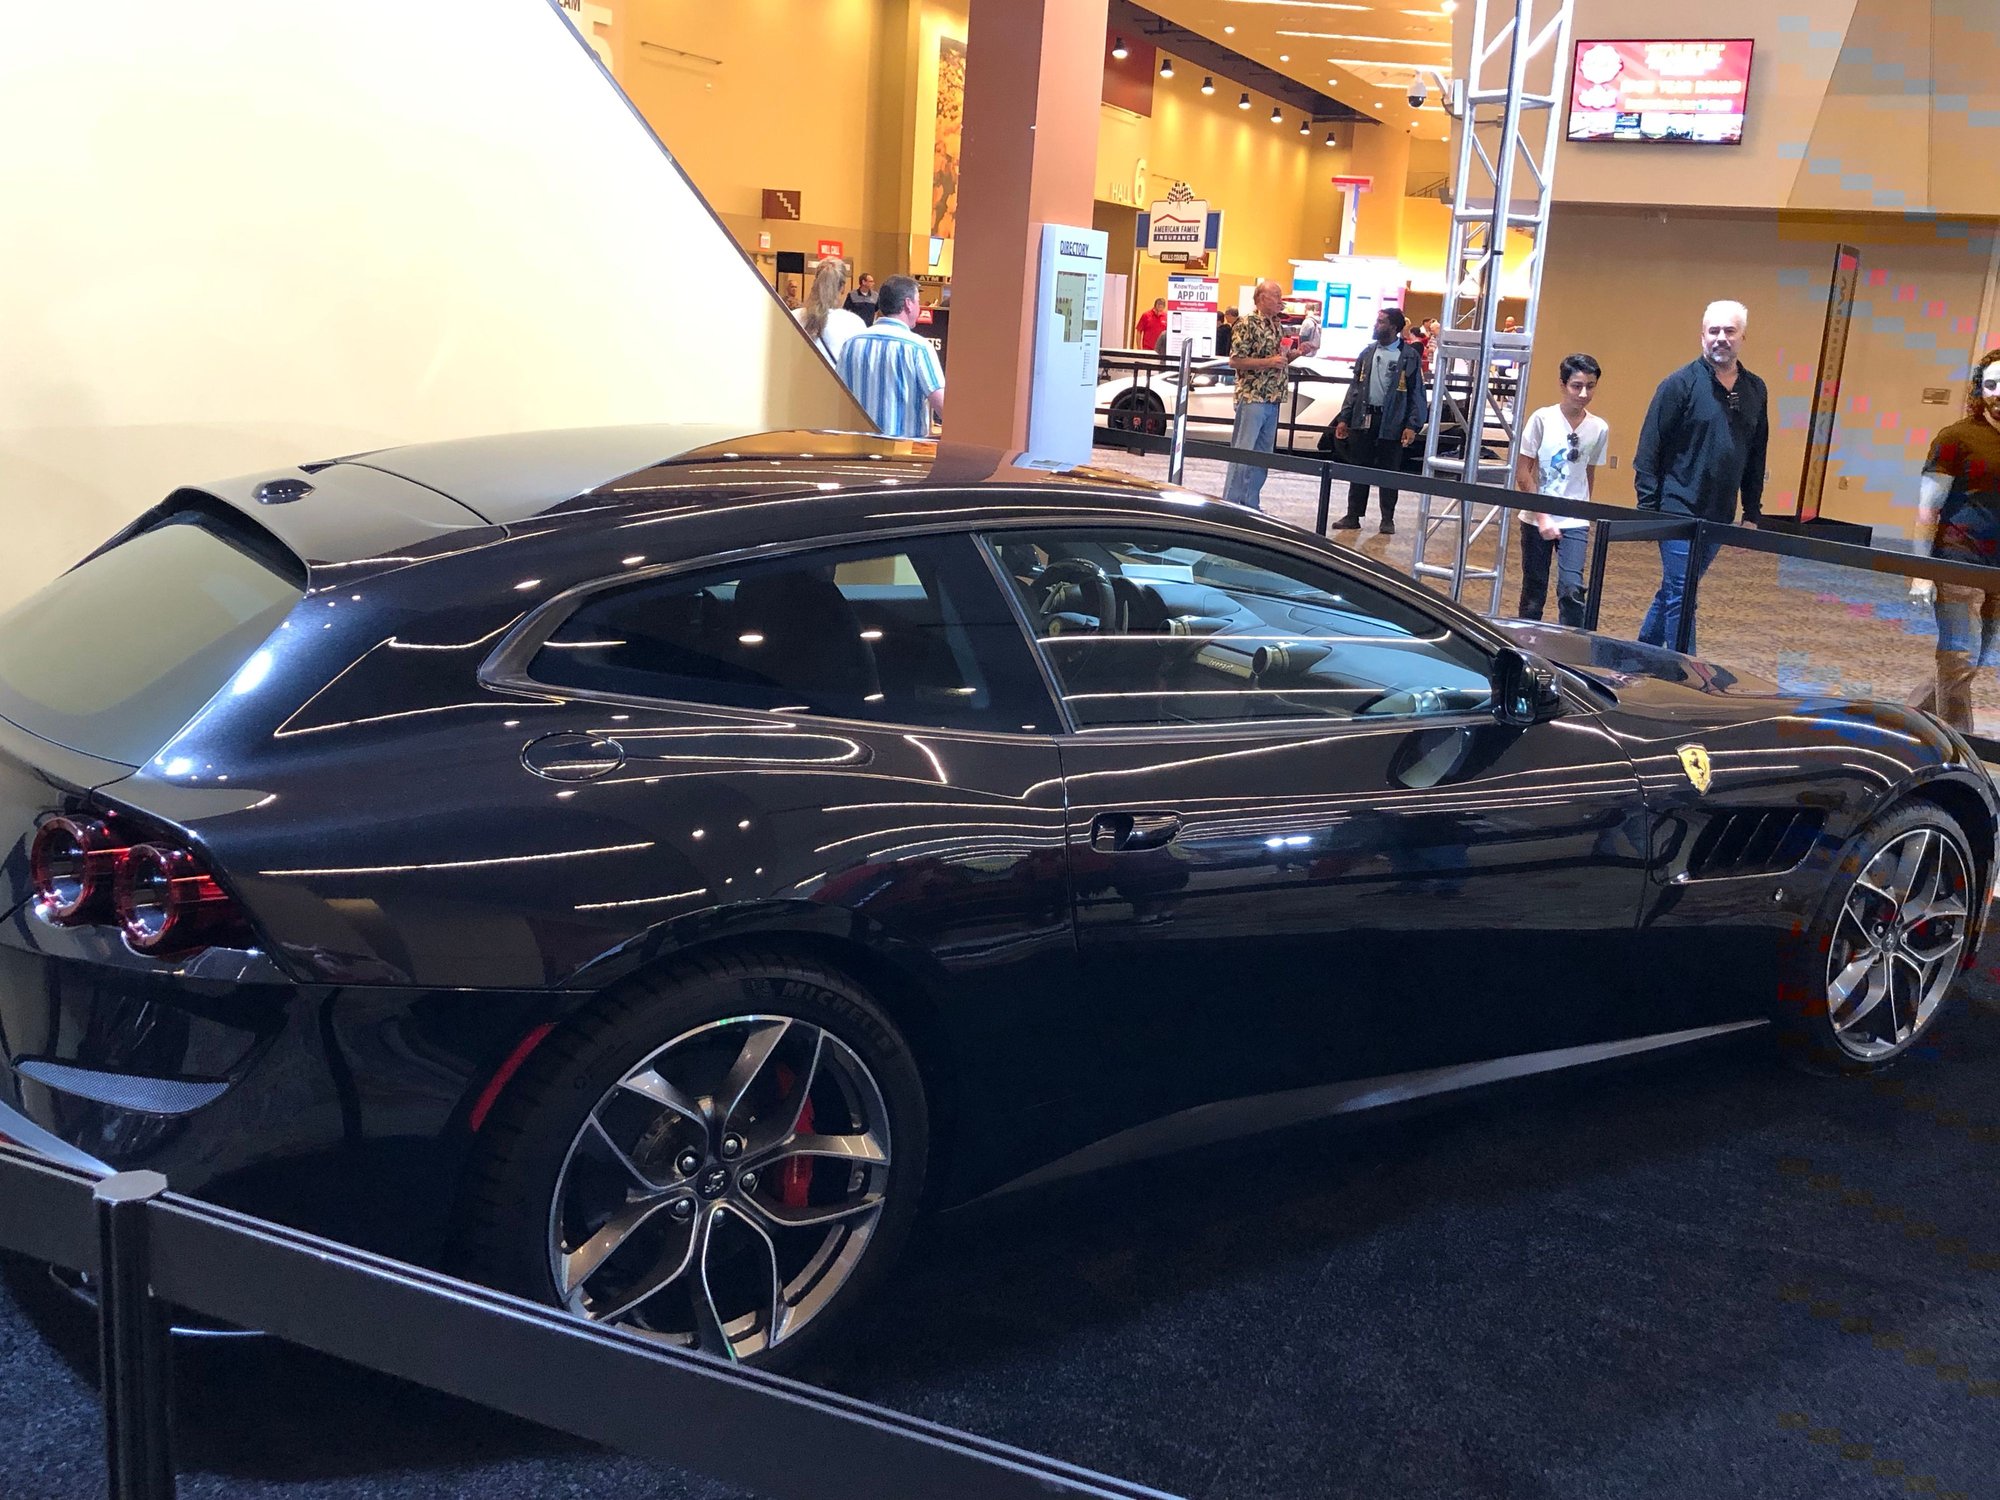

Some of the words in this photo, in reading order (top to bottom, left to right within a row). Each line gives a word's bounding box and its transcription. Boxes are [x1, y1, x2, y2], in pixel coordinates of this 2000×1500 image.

[1111, 183, 1132, 205] HALL
[1134, 158, 1147, 206] 6
[1154, 225, 1180, 233] AMERICAN
[1180, 225, 1200, 233] FAMILY
[1060, 240, 1089, 256] DIRECTORY
[1177, 290, 1195, 301] APP
[1196, 291, 1209, 301] 101
